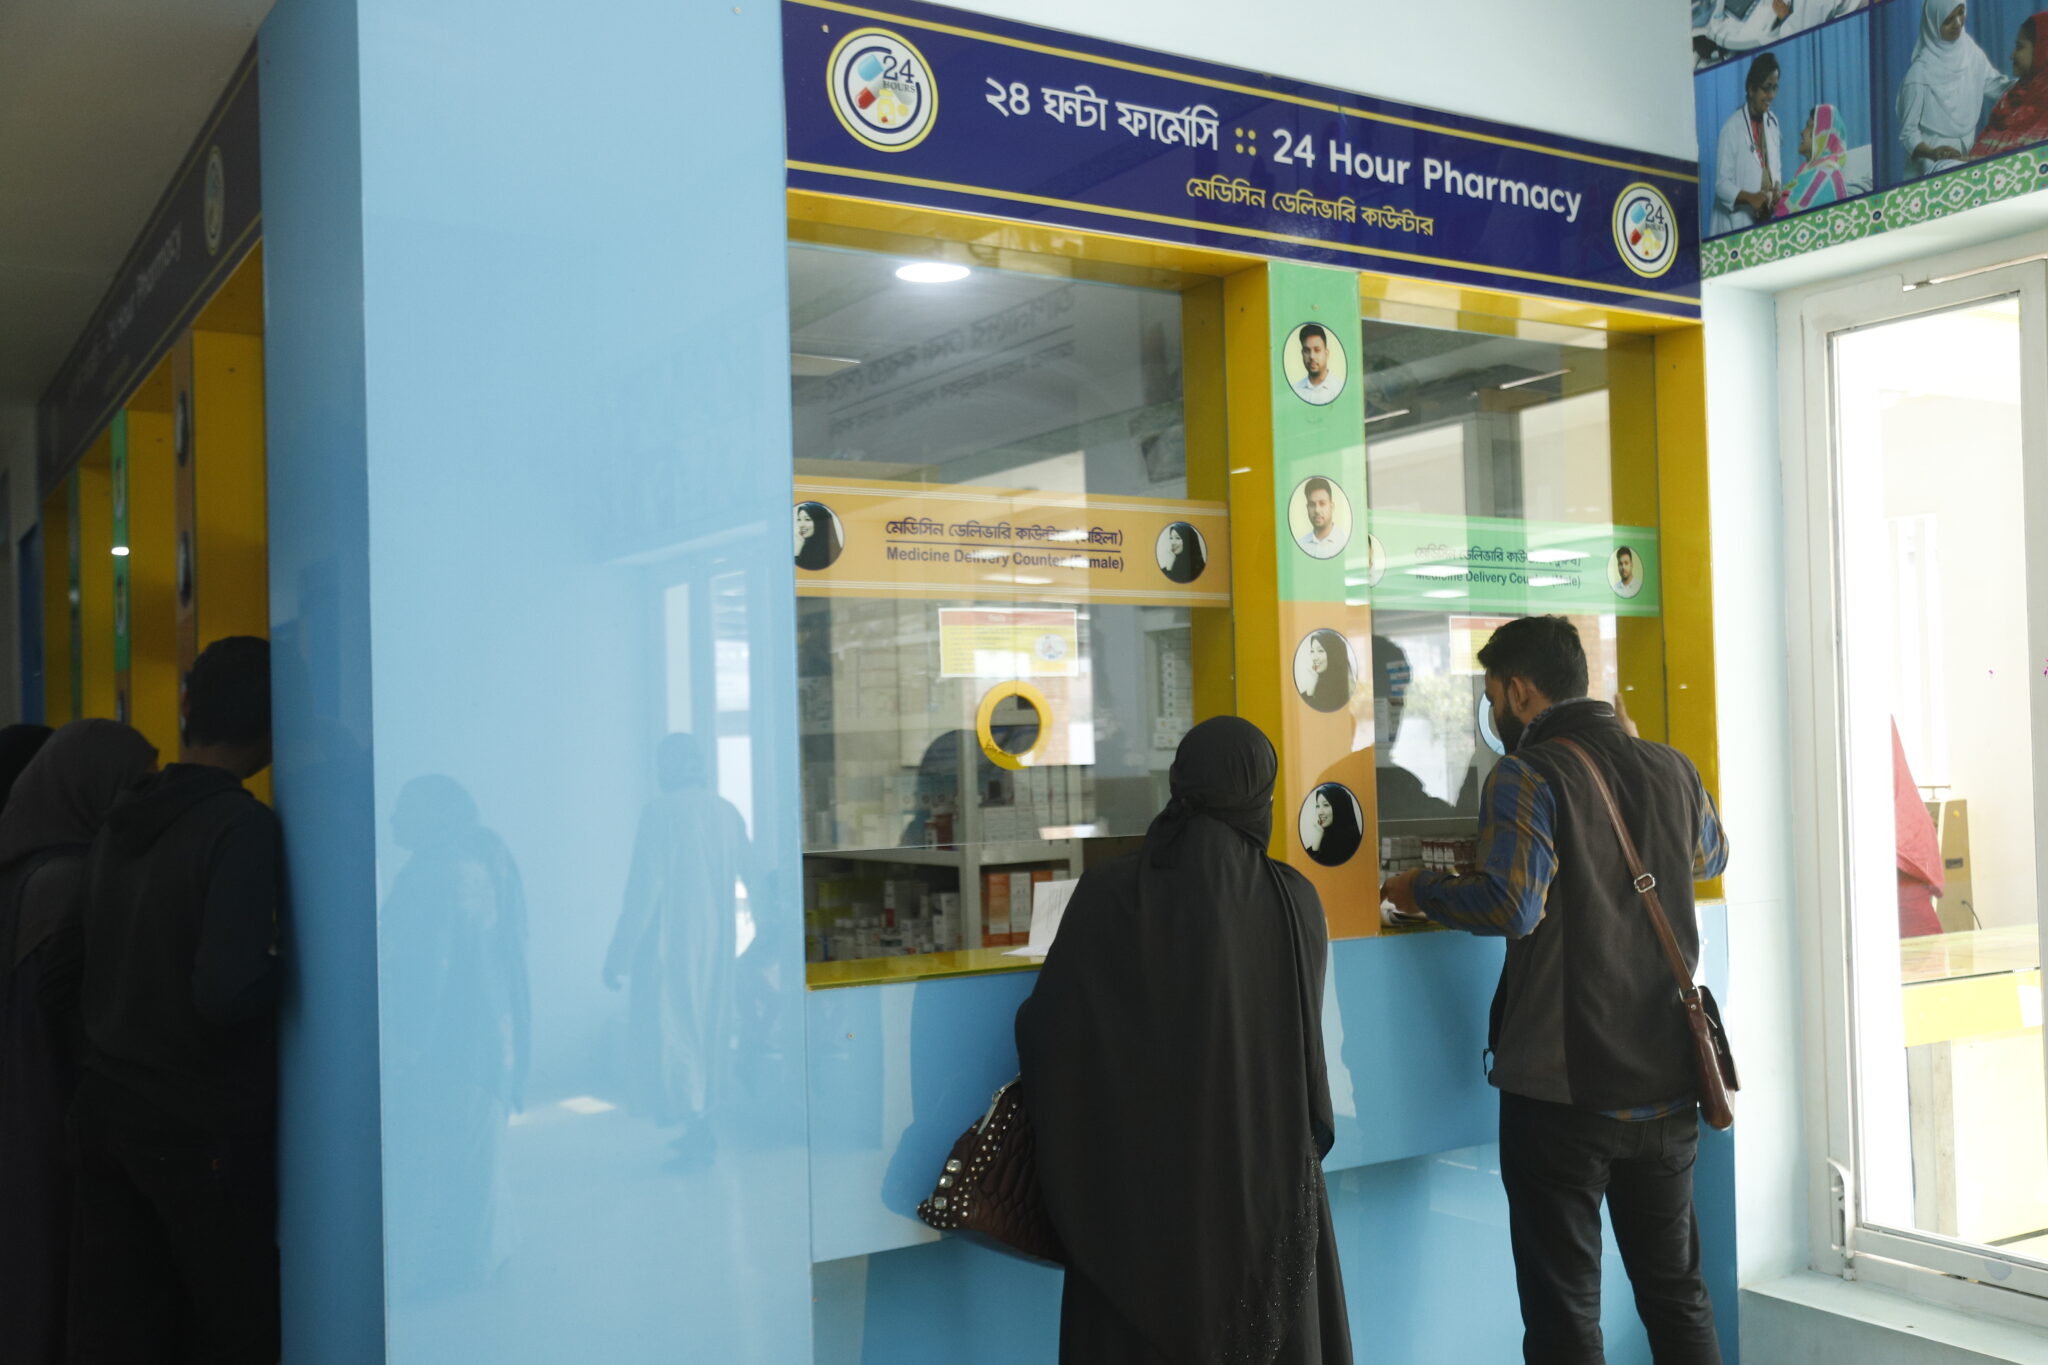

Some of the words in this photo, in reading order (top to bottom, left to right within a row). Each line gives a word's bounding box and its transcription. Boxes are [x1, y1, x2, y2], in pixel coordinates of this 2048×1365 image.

[883, 55, 915, 84] 24
[985, 76, 1031, 118] ২৪
[1115, 102, 1220, 151] ফার্মেসি
[1272, 128, 1316, 168] 24
[1329, 139, 1411, 185] Hour
[1423, 157, 1582, 223] Pharmacy
[1186, 174, 1267, 208] মেডিসিন
[1272, 189, 1357, 223] ডেলিভারি
[1645, 203, 1665, 224] 24
[886, 517, 945, 535] মেডিসিন
[949, 520, 1012, 540] ডেলিভারি
[887, 546, 950, 562] Medicine
[1070, 553, 1125, 573] (male)
[1466, 571, 1506, 587] Delivery
